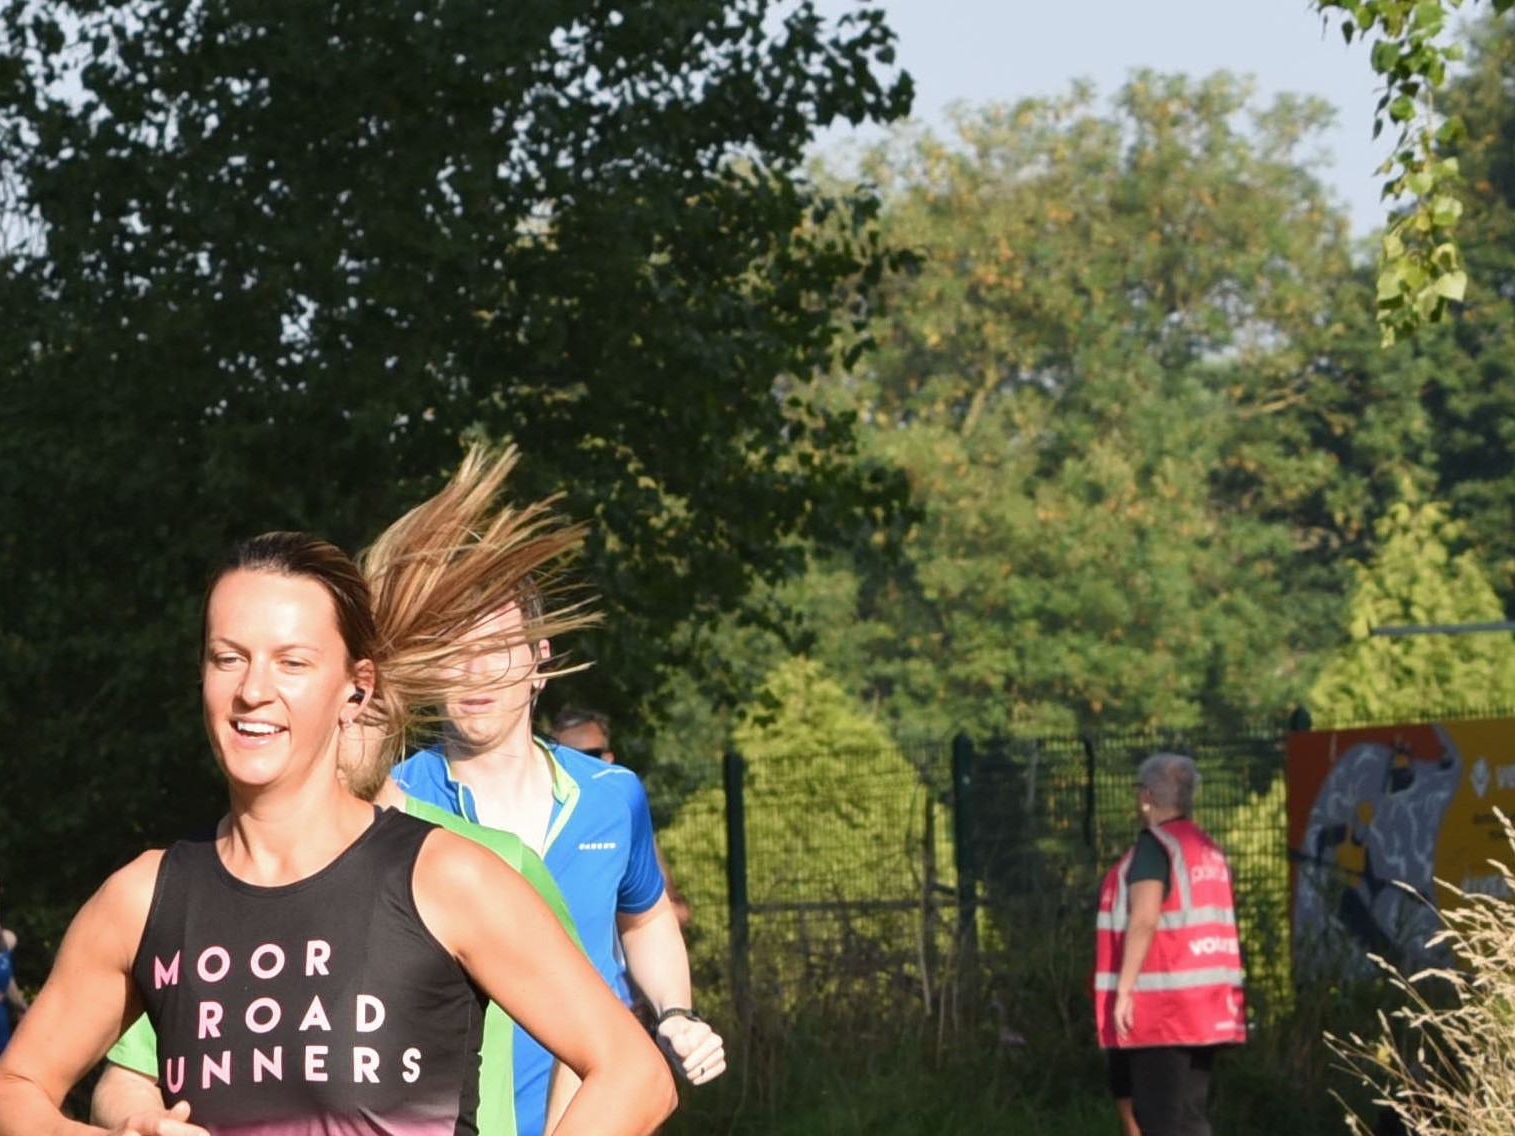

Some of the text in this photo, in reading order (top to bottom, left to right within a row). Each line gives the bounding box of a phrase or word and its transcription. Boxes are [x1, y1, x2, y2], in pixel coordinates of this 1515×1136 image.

[154, 939, 332, 990] MOOR
[197, 994, 386, 1040] ROAD
[166, 1045, 422, 1094] UNNERS
